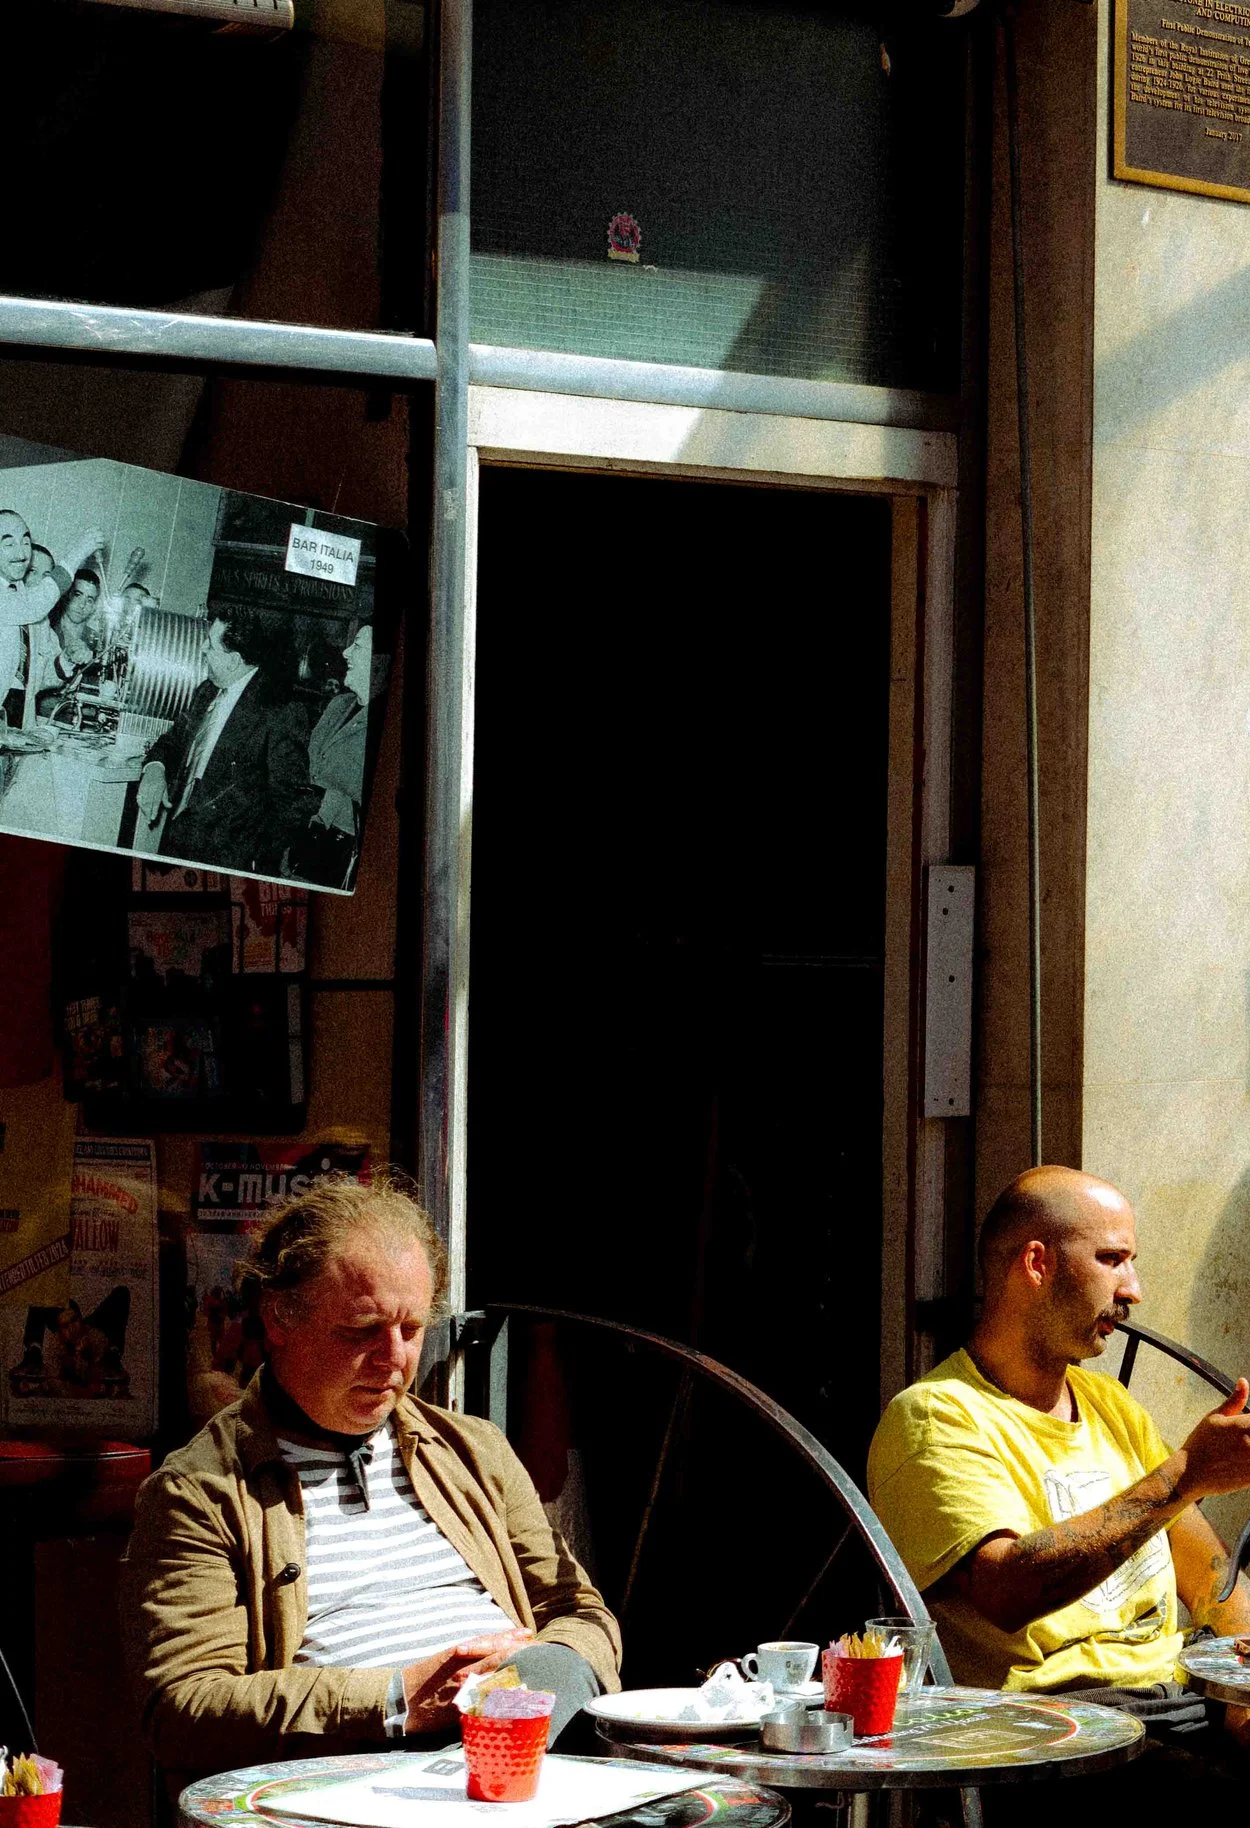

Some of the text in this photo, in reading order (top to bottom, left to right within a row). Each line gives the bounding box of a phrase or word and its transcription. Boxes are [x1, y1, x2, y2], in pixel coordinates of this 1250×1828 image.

[1196, 6, 1212, 17] AND
[1162, 18, 1176, 29] First
[1177, 22, 1194, 33] Public
[1131, 32, 1157, 45] Members
[1180, 42, 1197, 55] Royal
[1188, 54, 1227, 70] demonstration
[1205, 127, 1227, 140] January
[292, 537, 354, 562] BAR ITALIA
[310, 558, 334, 575] 1949
[47, 1239, 69, 1263] 2024
